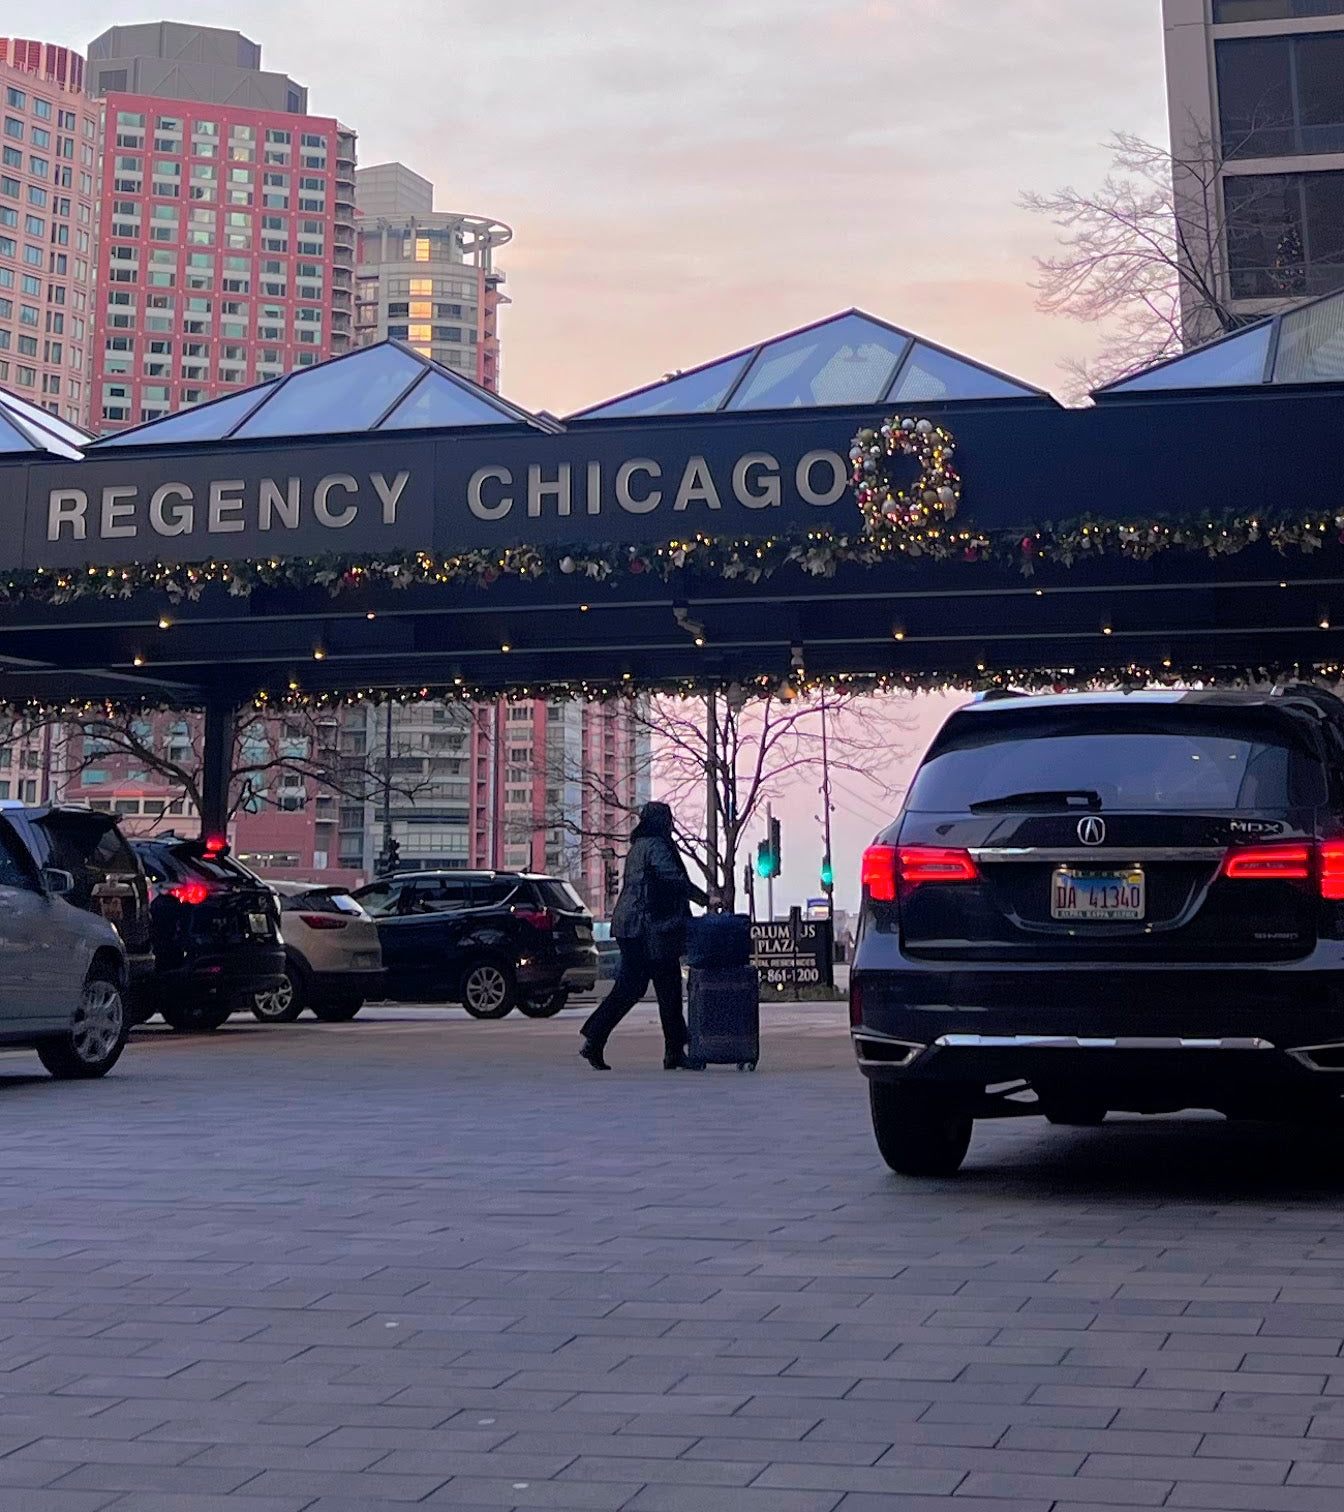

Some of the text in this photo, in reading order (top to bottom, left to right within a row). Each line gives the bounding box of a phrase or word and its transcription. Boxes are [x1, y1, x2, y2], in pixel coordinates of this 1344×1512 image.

[47, 471, 410, 542] REGENCY
[466, 449, 849, 521] CHICAGO
[1230, 821, 1279, 832] MDX
[1057, 886, 1140, 909] DA 41340
[750, 924, 816, 939] OLUMUS
